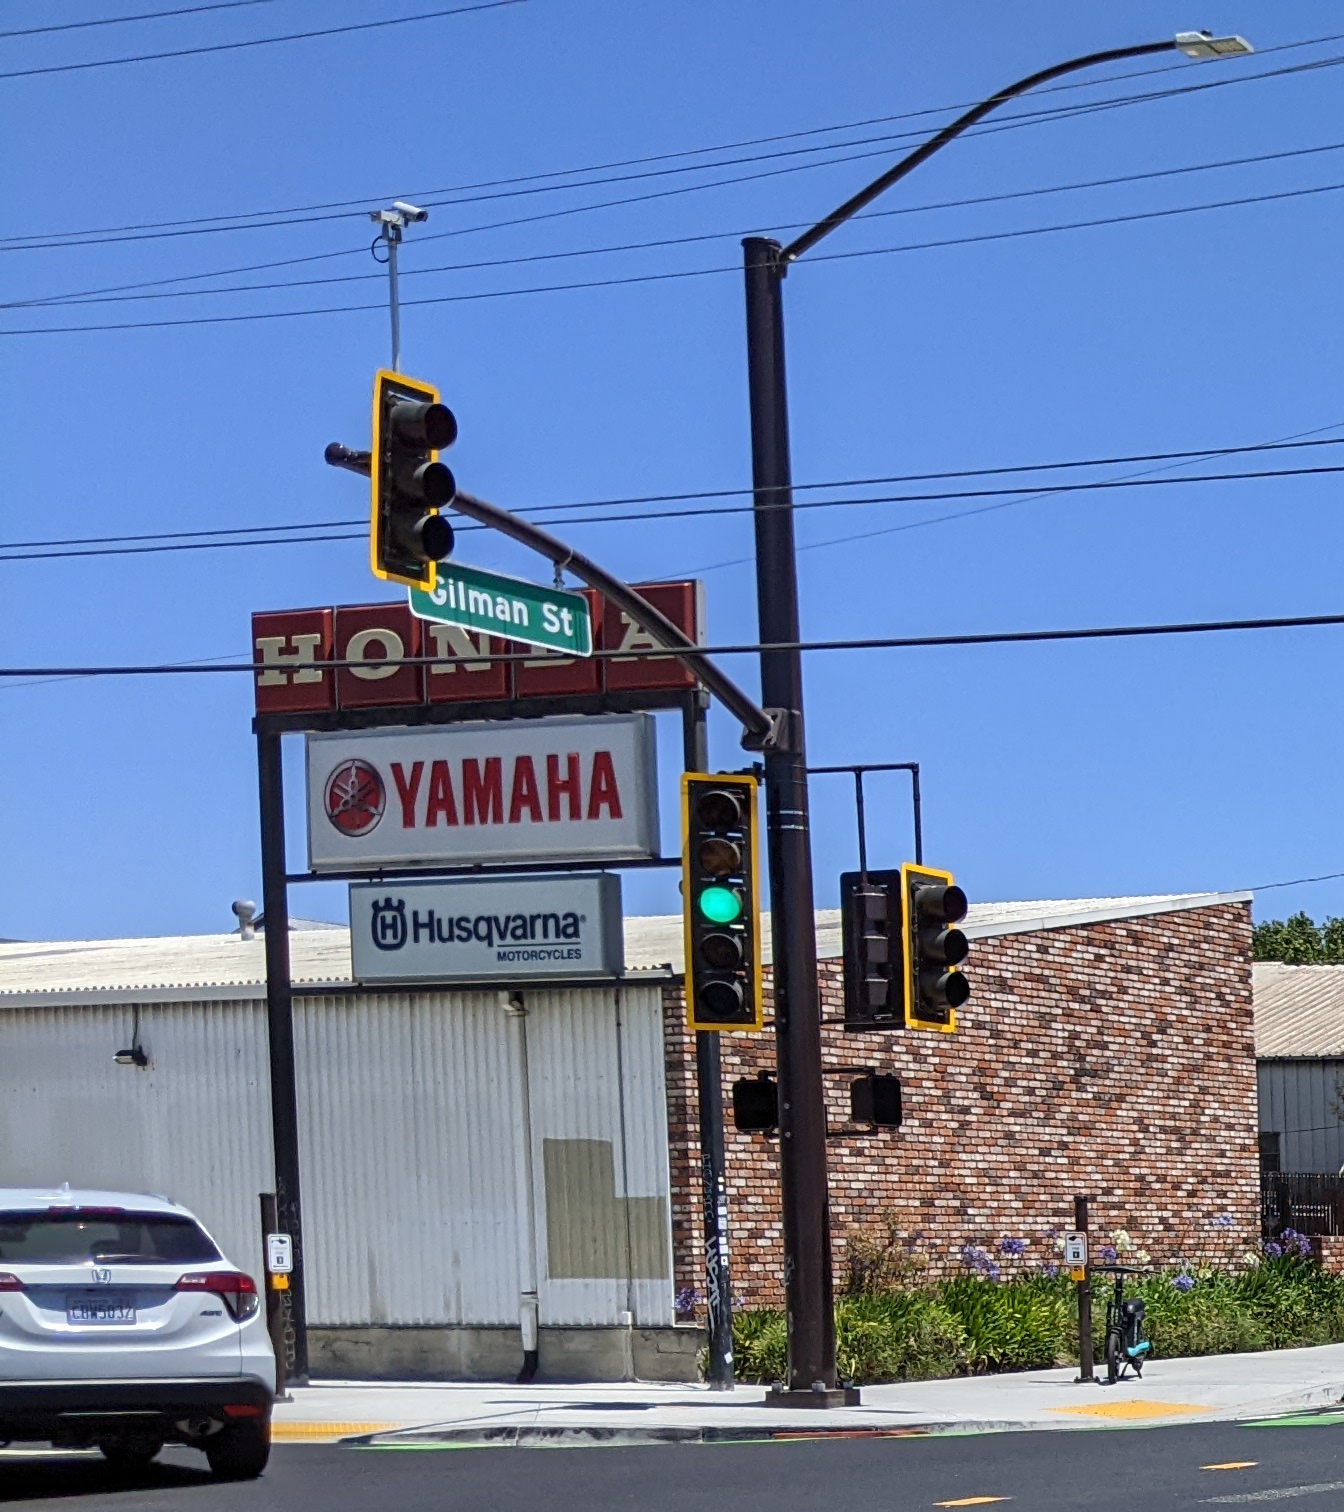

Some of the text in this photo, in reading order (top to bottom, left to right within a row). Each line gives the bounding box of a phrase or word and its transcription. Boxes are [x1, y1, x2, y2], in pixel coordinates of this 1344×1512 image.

[429, 575, 574, 637] Gilman St
[390, 751, 623, 829] YAMAHA
[412, 909, 581, 947] Husqvarna
[497, 949, 582, 962] MOTORCYCLES
